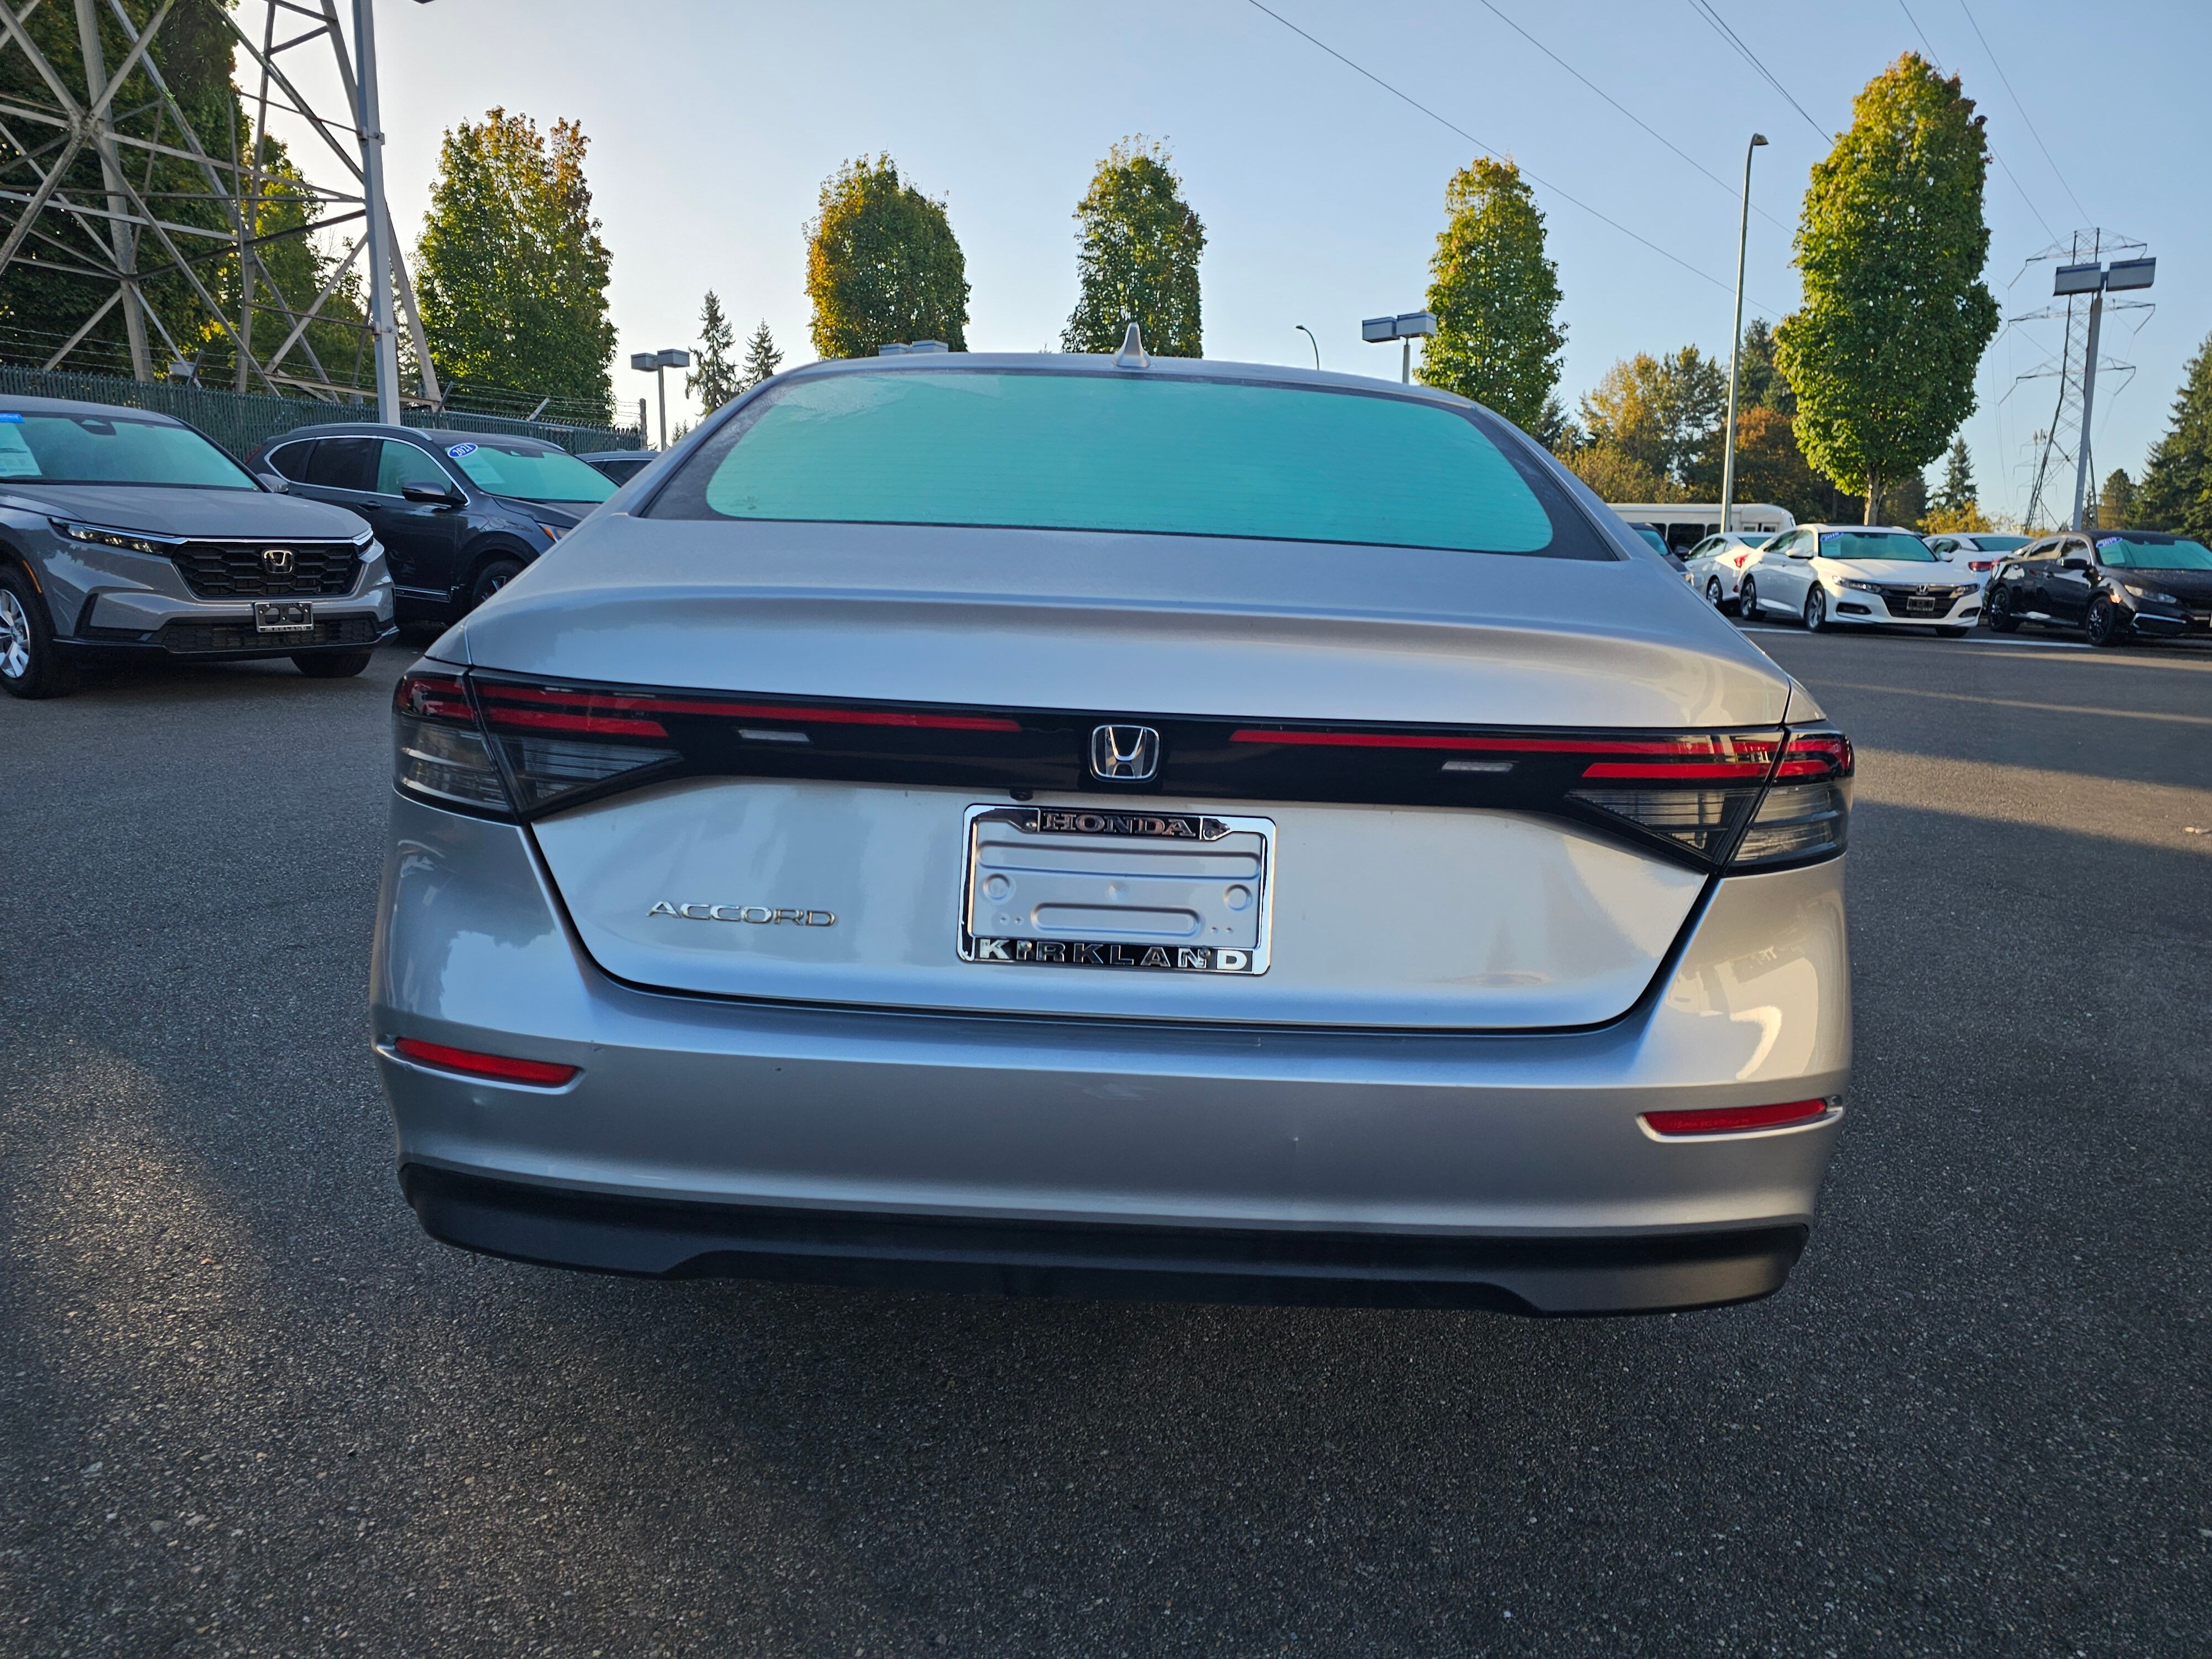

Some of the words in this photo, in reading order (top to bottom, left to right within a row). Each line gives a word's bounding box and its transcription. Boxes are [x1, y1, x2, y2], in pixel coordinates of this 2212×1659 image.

[452, 445, 472, 456] 2021
[1043, 813, 1196, 837] HONDA
[646, 901, 836, 926] ACCORD
[979, 938, 1248, 969] KIRKLAND
